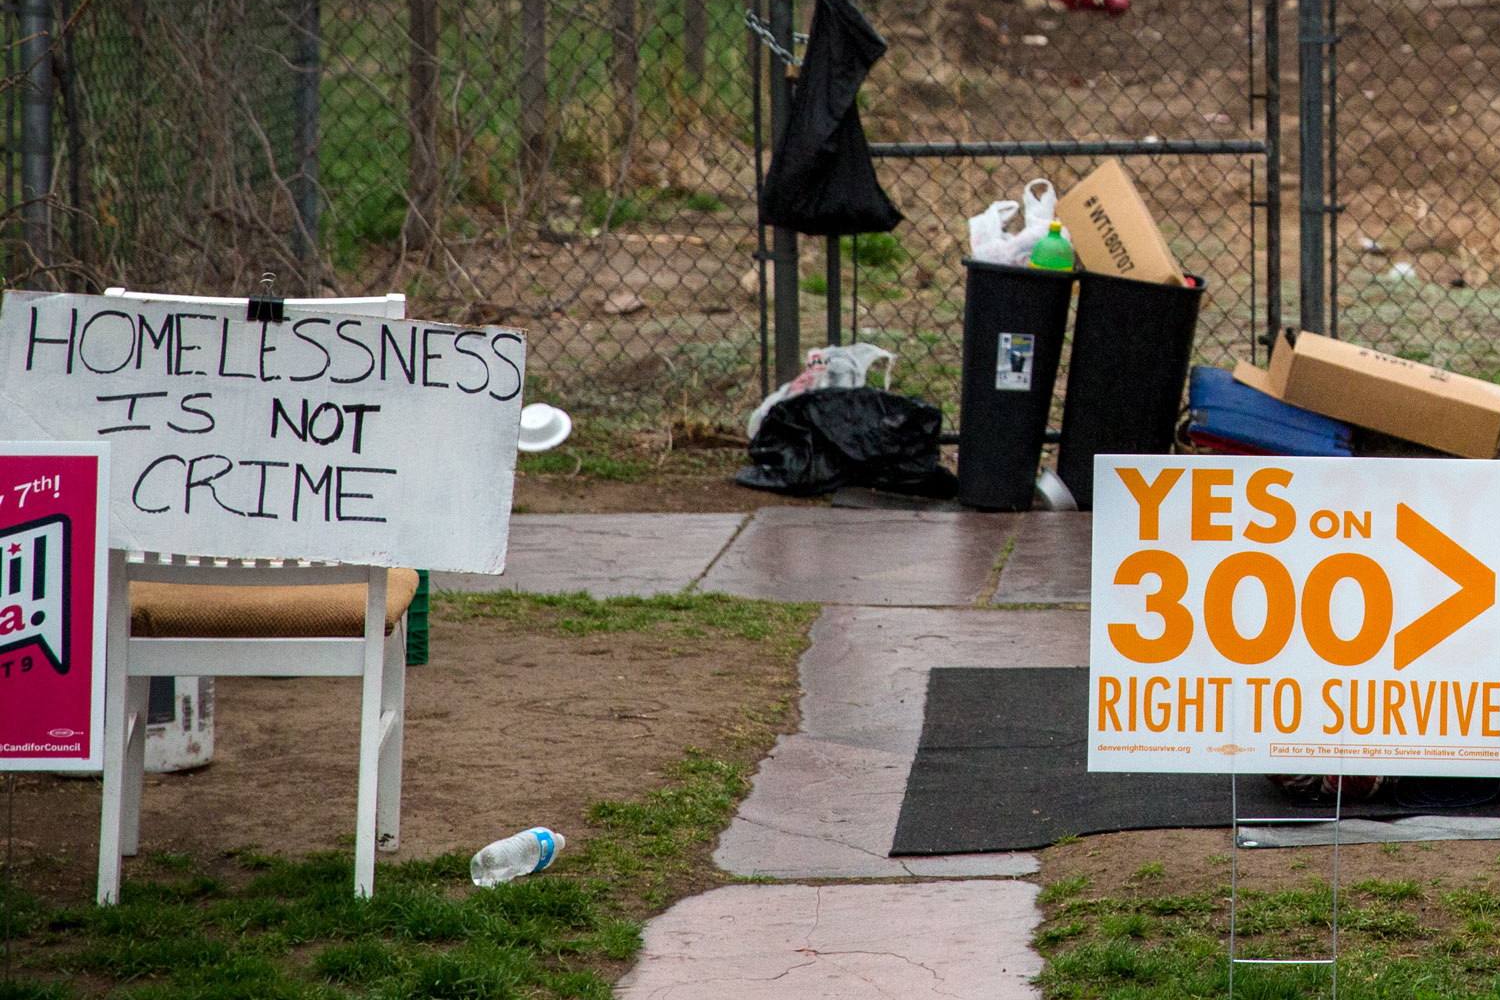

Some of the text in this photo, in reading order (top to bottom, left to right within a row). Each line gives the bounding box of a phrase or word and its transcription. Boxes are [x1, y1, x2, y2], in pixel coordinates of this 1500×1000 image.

[25, 306, 522, 401] HOMELESSNESS
[97, 392, 381, 454] IS NOT
[14, 475, 60, 508] 7th!
[132, 454, 397, 522] CRIME
[1114, 467, 1372, 544] YES ON
[1107, 549, 1394, 666] 300
[1098, 676, 1233, 733] RIGHT
[1246, 677, 1301, 734] TO
[1097, 744, 1191, 754] denverrighttosurvive.org
[1305, 747, 1316, 755] by
[1363, 747, 1382, 756] Right
[1458, 749, 1499, 757] Committee
